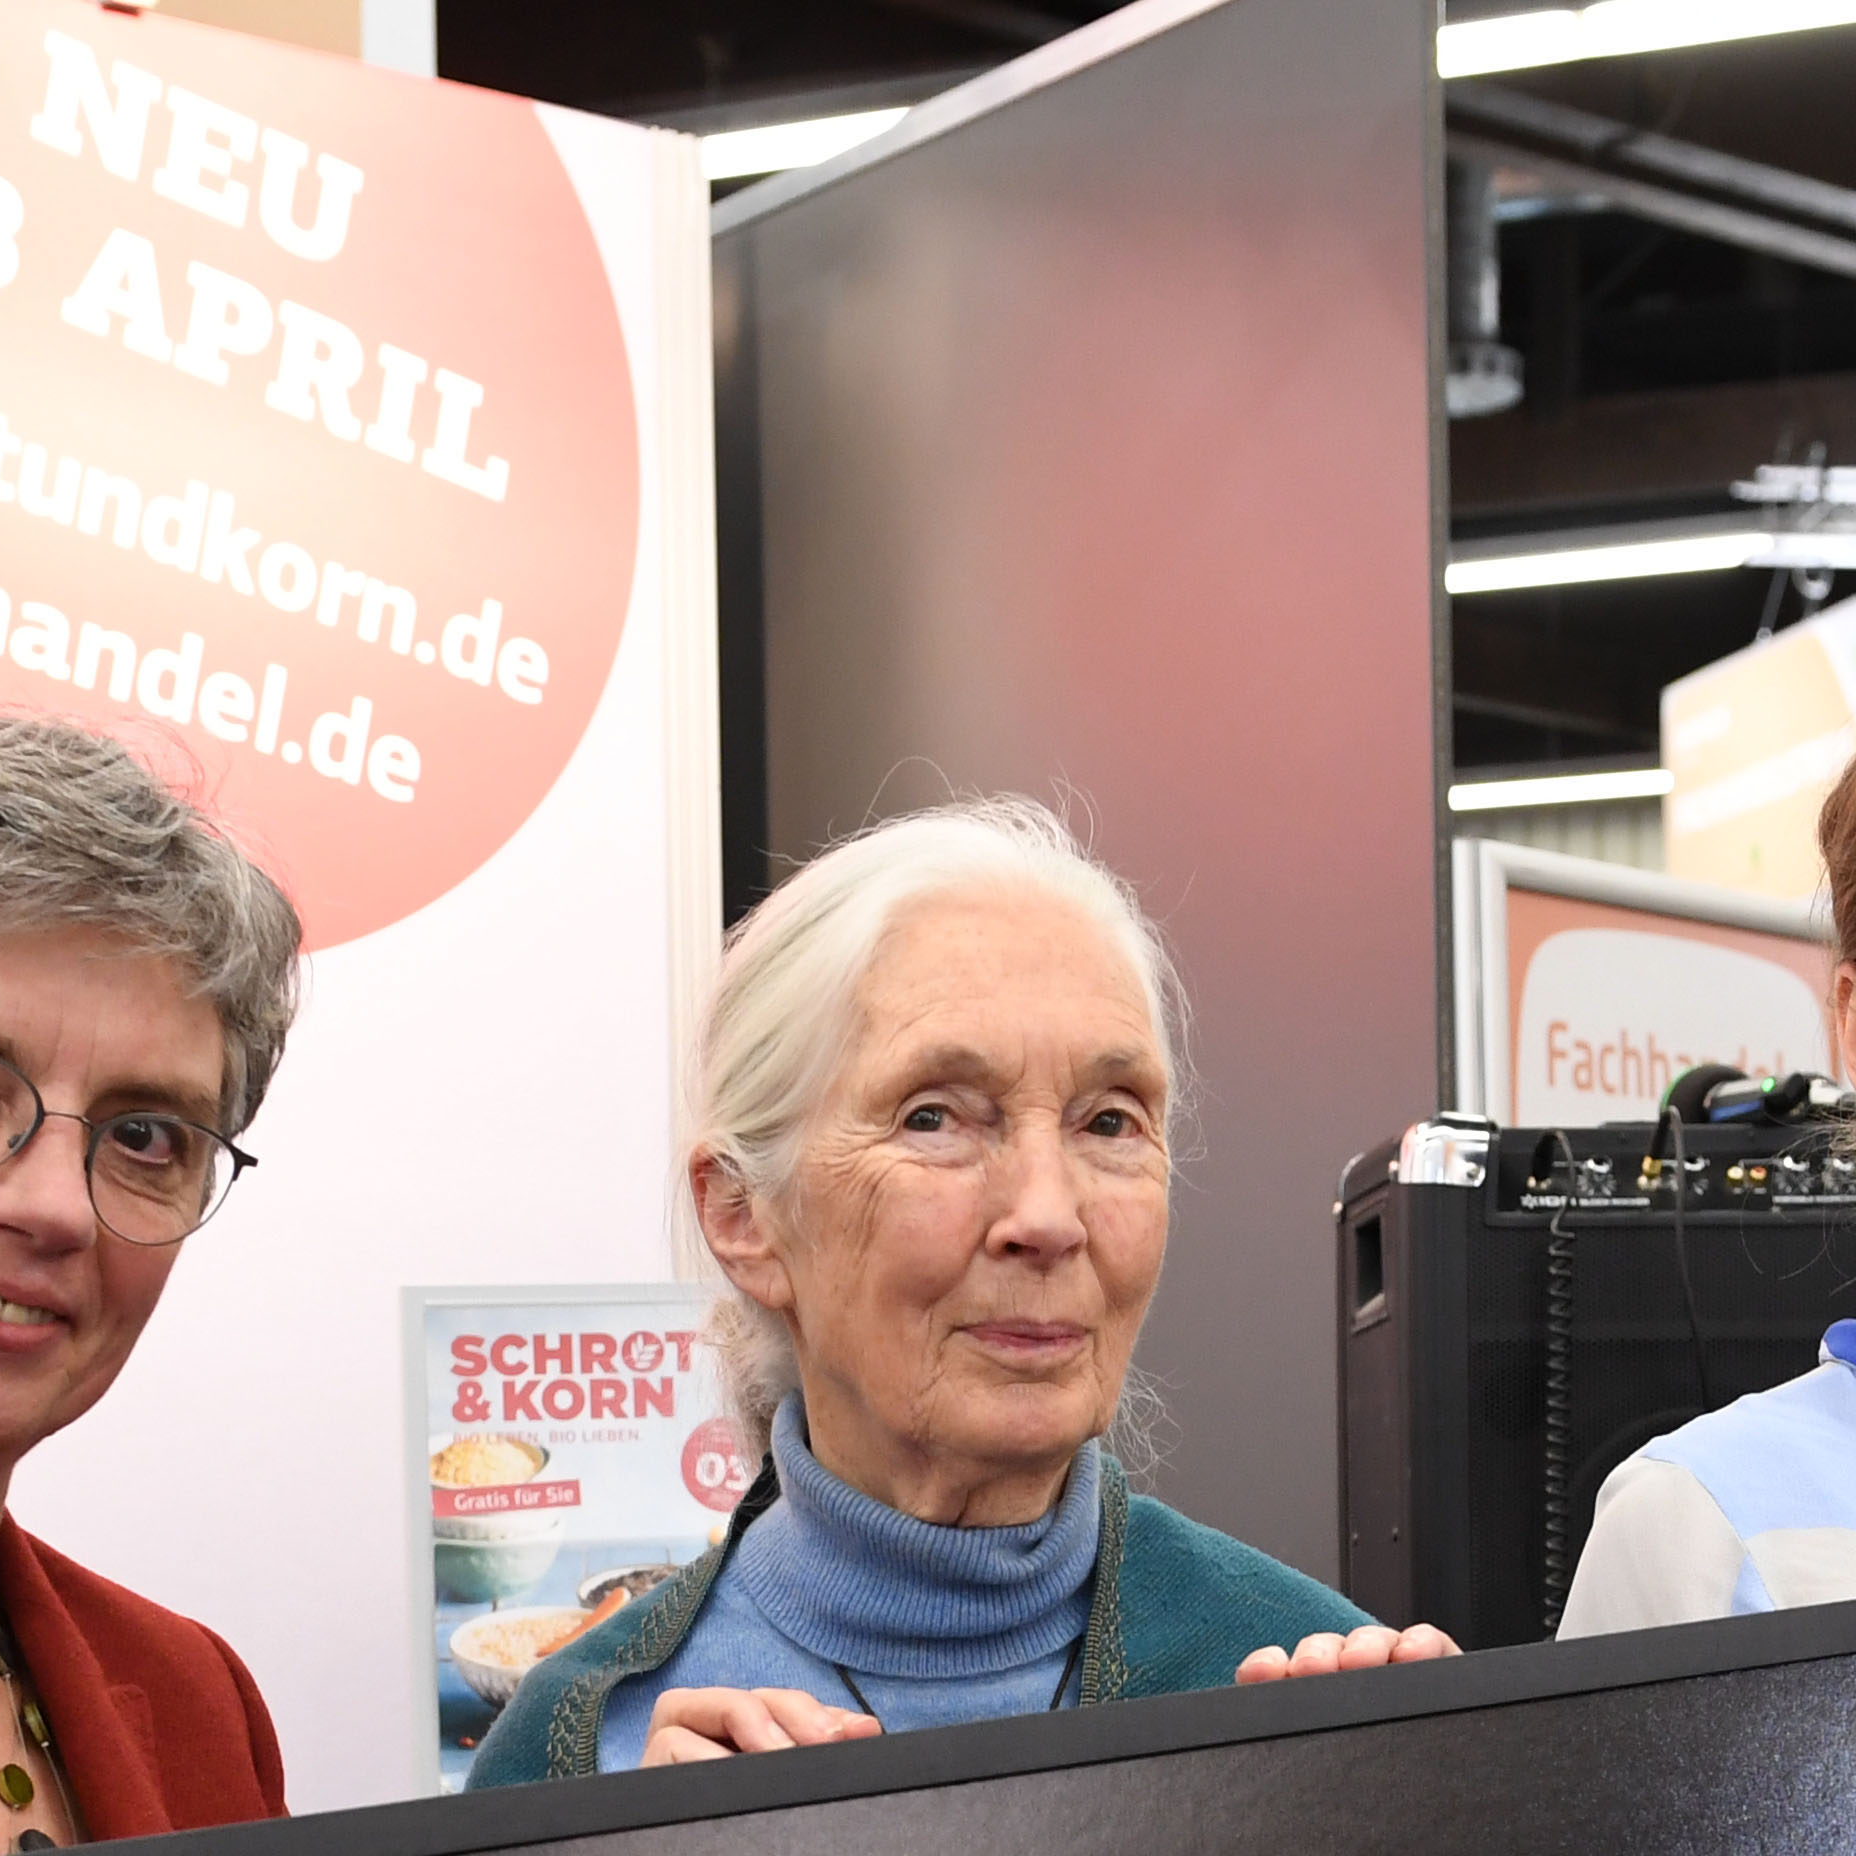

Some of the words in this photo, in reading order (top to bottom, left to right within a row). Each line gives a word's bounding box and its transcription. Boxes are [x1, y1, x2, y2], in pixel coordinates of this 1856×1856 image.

[29, 28, 364, 262] NEU
[60, 227, 510, 502] APRIL
[1547, 1020, 1785, 1100] Fachh
[450, 1330, 696, 1377] SCHROT
[452, 1380, 491, 1423] &
[502, 1376, 674, 1421] KORN
[549, 1429, 577, 1443] BIO
[454, 1492, 509, 1513] Gratis
[514, 1488, 541, 1507] für
[546, 1487, 574, 1505] Sie
